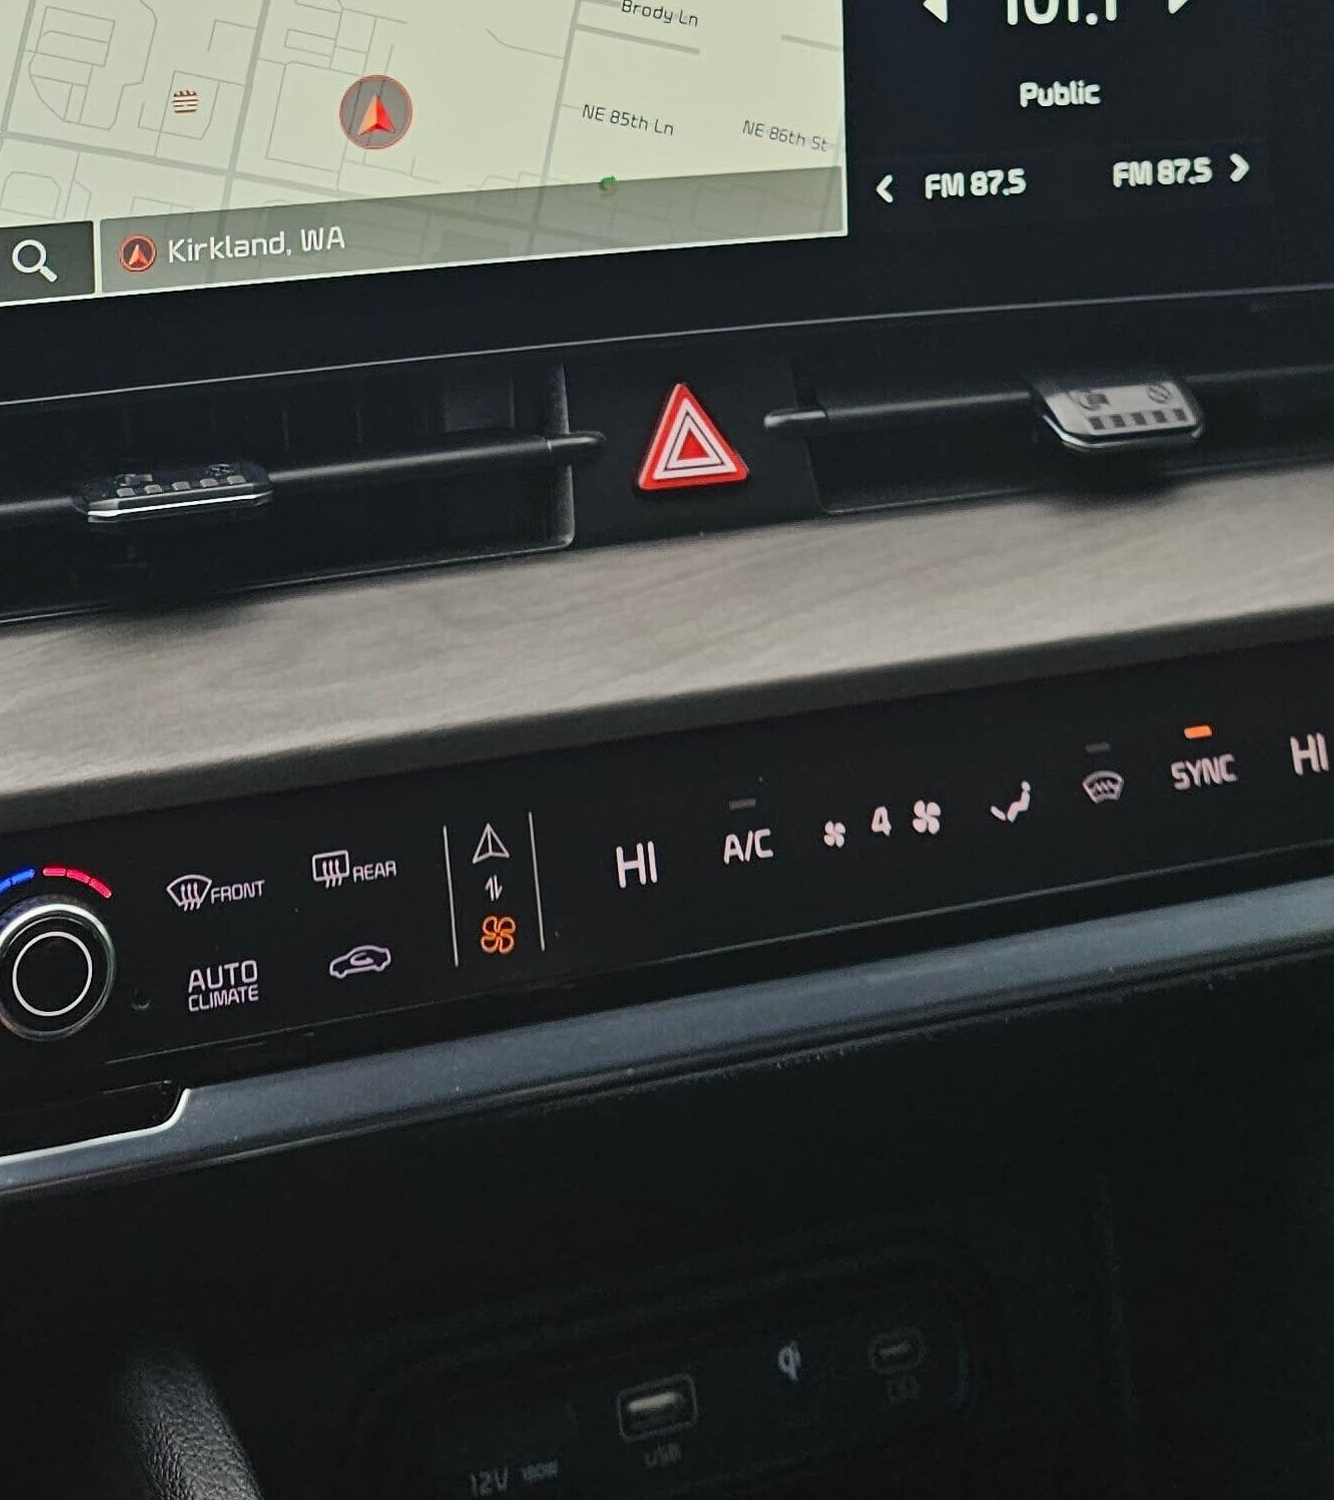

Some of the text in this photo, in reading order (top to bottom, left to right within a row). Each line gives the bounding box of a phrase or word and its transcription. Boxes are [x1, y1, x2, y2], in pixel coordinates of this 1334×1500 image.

[678, 9, 699, 27] Ln
[1019, 80, 1101, 108] Public
[582, 103, 675, 137] NE 85th Ln
[742, 119, 828, 152] NE 86th St
[924, 168, 1027, 200] FM 87.5
[1112, 157, 1214, 188] FM 87.5
[168, 226, 346, 263] Kirkland, WA
[1289, 732, 1329, 777] HI
[1170, 753, 1239, 790] SYNC
[870, 805, 891, 836] 4
[723, 828, 774, 865] A/C
[352, 860, 398, 883] REAR
[615, 840, 659, 889] HI
[210, 879, 266, 905] FRONT
[188, 959, 258, 993] AUTO
[188, 984, 259, 1012] CLIMATE
[469, 1467, 509, 1498] 12V
